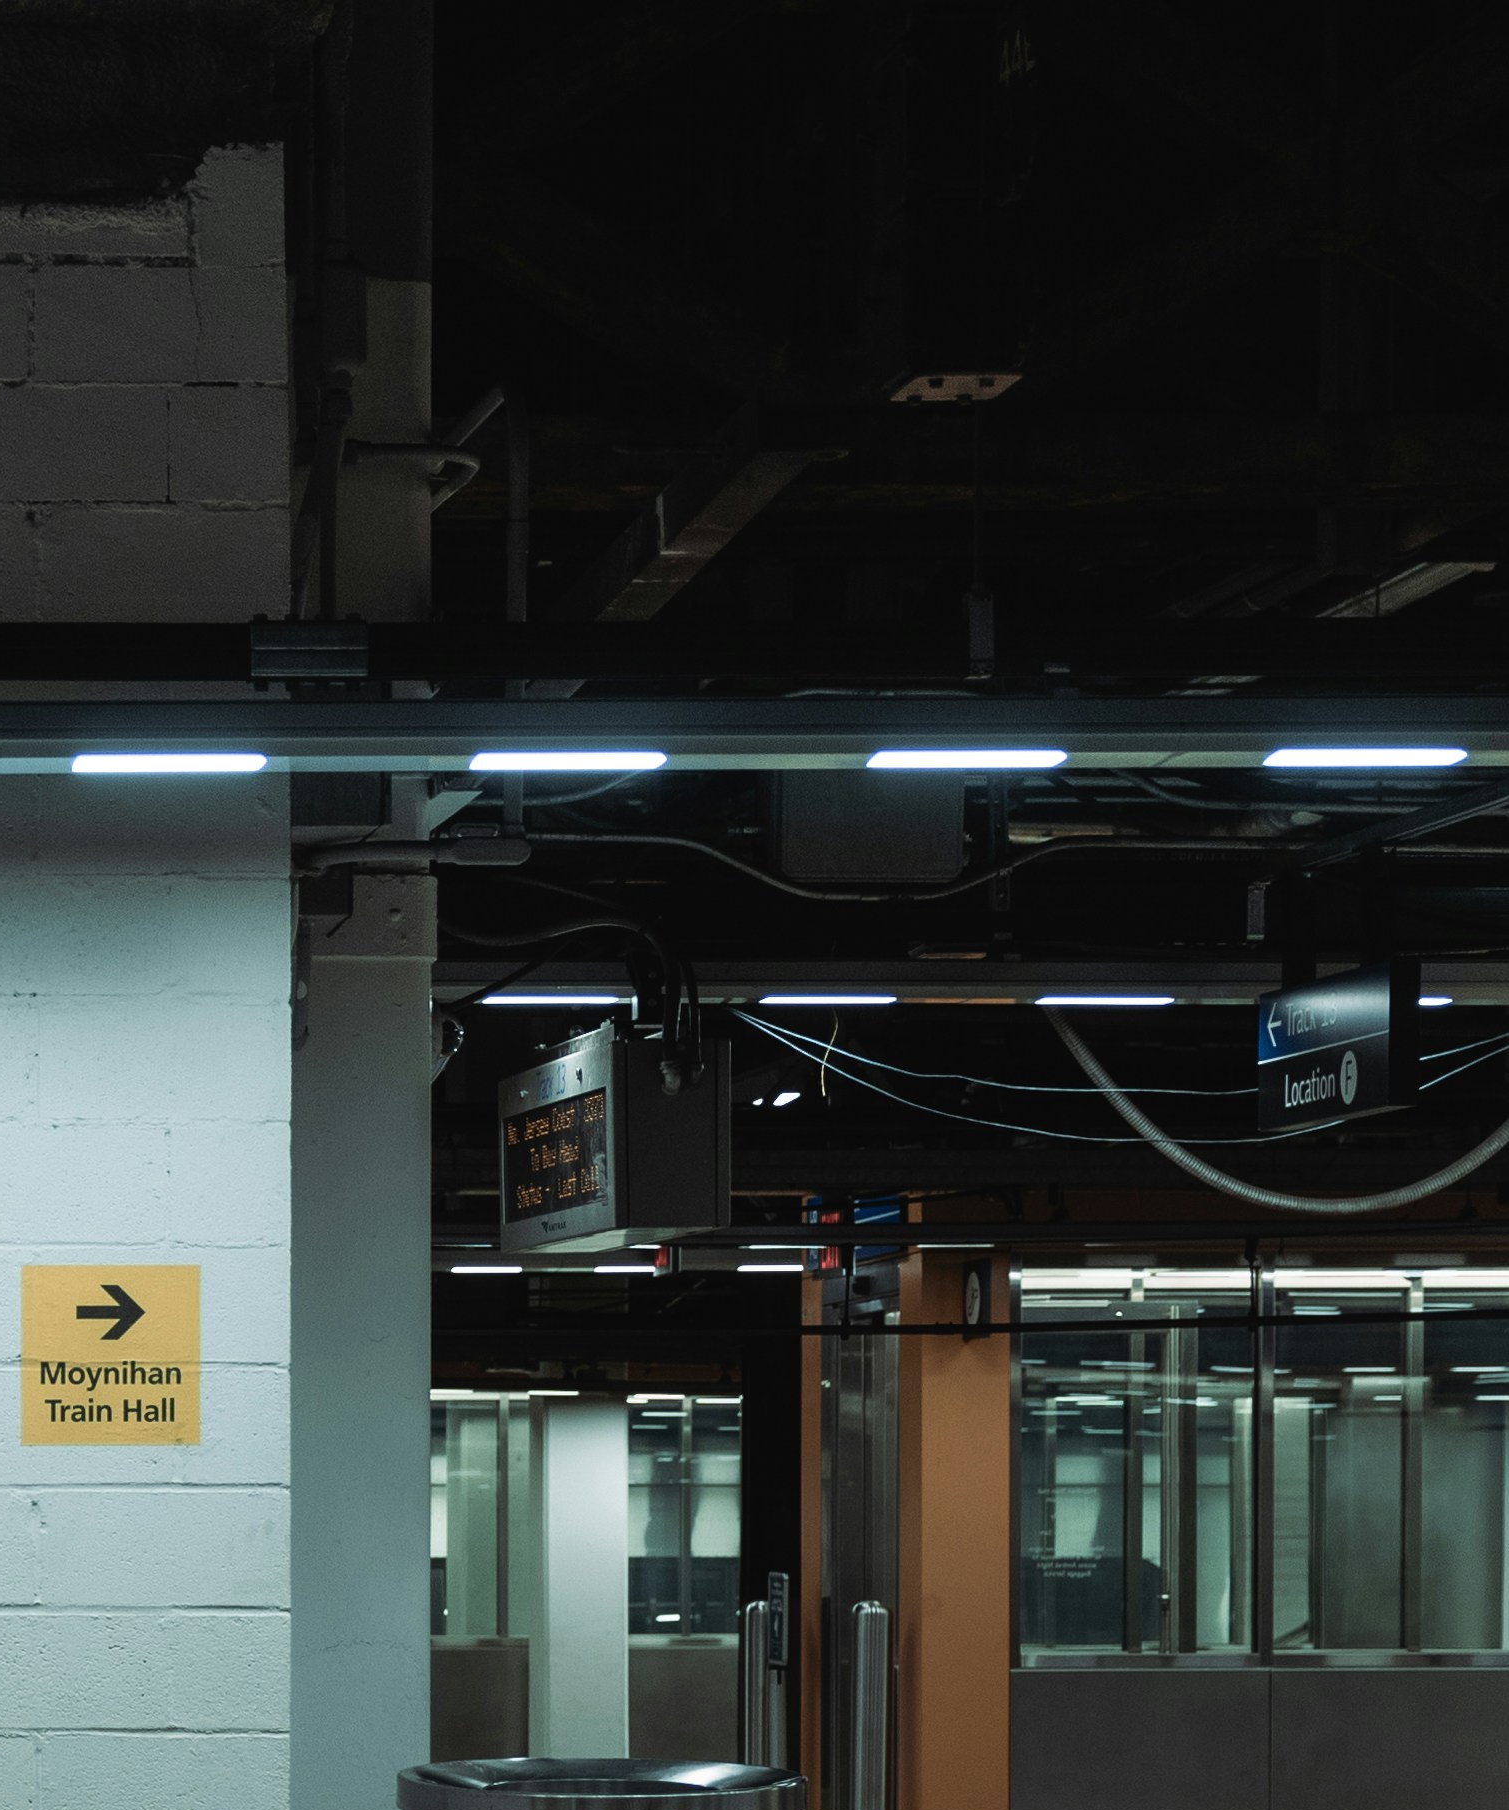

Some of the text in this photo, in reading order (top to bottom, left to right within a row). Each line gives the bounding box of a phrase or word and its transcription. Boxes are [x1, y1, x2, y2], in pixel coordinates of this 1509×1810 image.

[1285, 1002, 1316, 1037] Track
[556, 1063, 567, 1096] 13
[1284, 1067, 1335, 1108] Location
[557, 1170, 578, 1200] Last
[580, 1165, 601, 1194] Call
[40, 1361, 182, 1392] Moynihan
[44, 1398, 176, 1423] Train Hall
